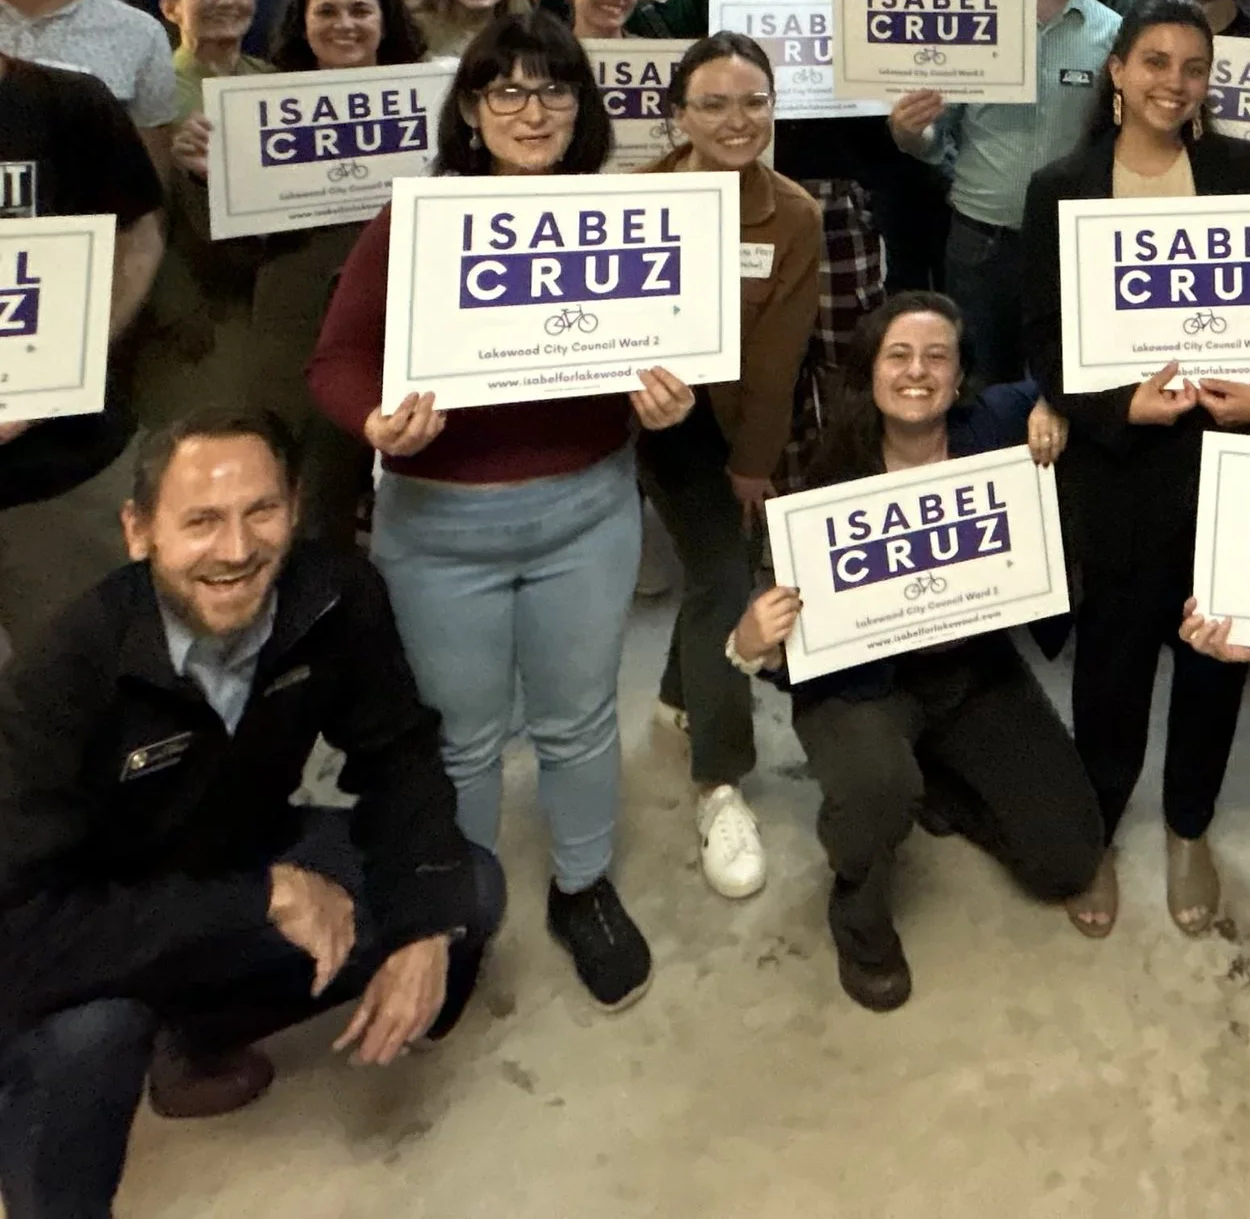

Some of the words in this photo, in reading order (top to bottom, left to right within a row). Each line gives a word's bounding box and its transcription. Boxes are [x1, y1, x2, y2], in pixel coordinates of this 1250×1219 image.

[747, 14, 826, 35] ISAB
[871, 15, 990, 40] CRUZ
[785, 40, 833, 62] RU
[600, 62, 681, 85] ISA
[259, 88, 426, 127] ISABEL
[603, 90, 662, 115] CR
[266, 121, 420, 160] CRUZ
[463, 208, 680, 251] ISABEL
[466, 252, 671, 300] CRUZ
[478, 345, 540, 360] Lakewood
[543, 343, 568, 356] City
[571, 339, 616, 352] Council
[619, 336, 650, 348] Ward
[653, 336, 660, 345] 2
[1132, 342, 1181, 353] Lakewood
[1184, 341, 1203, 351] City
[1205, 339, 1242, 349] Council
[826, 481, 1007, 547] ISABEL
[837, 518, 1002, 583] CRUZ
[856, 608, 904, 629] Lakewood
[906, 604, 926, 615] City
[928, 595, 963, 610] Council
[965, 589, 991, 601] Ward
